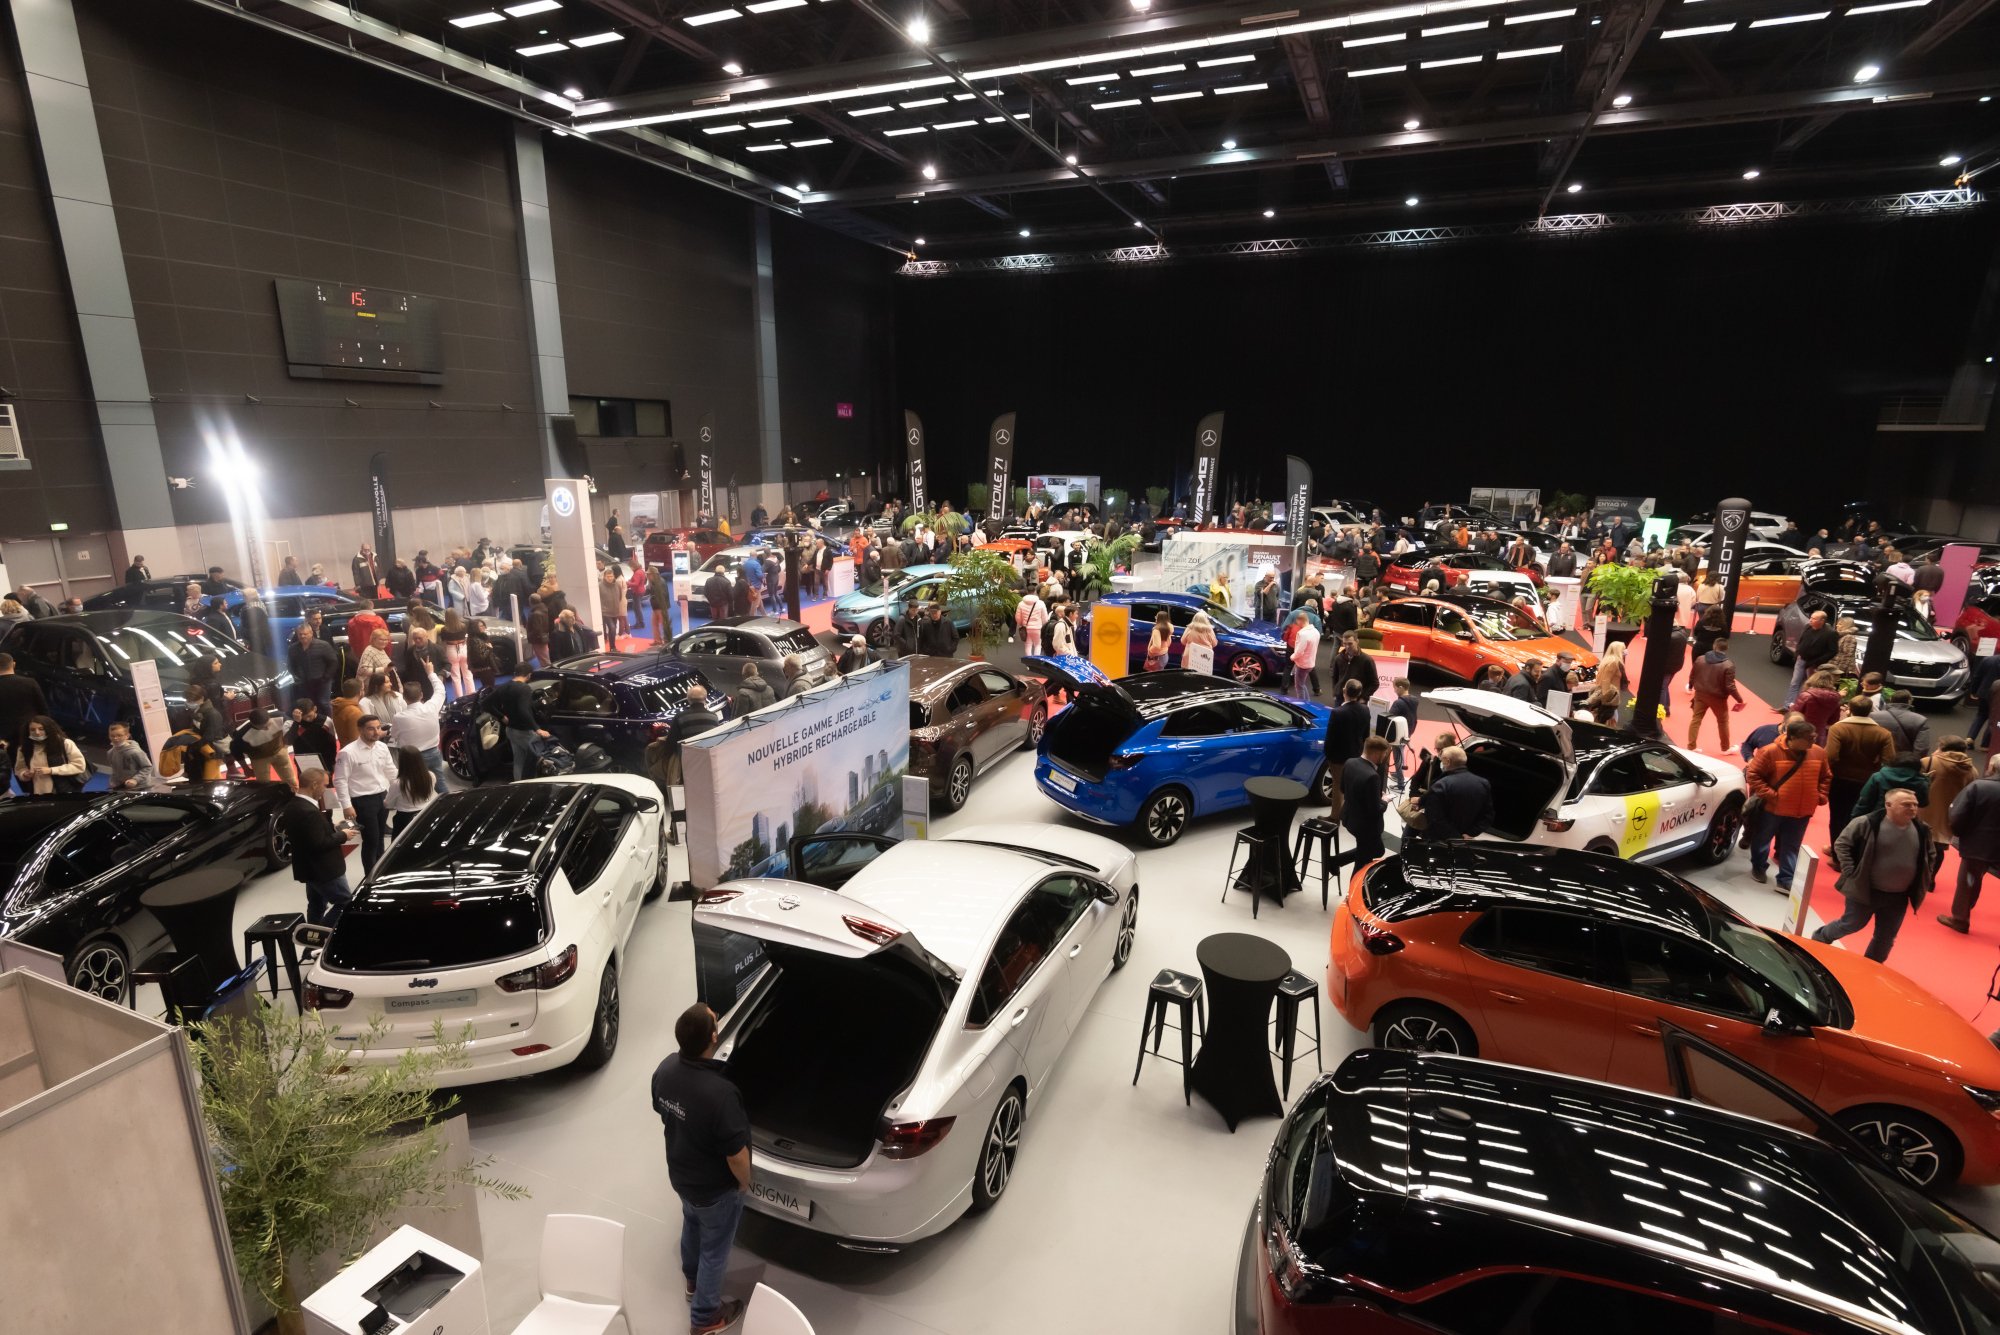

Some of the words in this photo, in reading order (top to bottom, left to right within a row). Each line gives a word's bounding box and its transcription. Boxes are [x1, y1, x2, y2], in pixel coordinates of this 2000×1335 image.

[701, 454, 709, 467] 71
[994, 457, 1004, 470] 71
[991, 473, 1003, 520] ETOILE
[1718, 536, 1734, 609] GEOT
[748, 731, 799, 766] NOUVELLE
[801, 715, 833, 740] GAMME
[773, 742, 813, 771] HYBRIDE
[815, 711, 876, 750] RECHARGEABLE
[735, 952, 754, 974] PLUS
[408, 977, 438, 989] Jeep
[391, 999, 430, 1008] Compass
[748, 1182, 799, 1211] NSIGNIA
